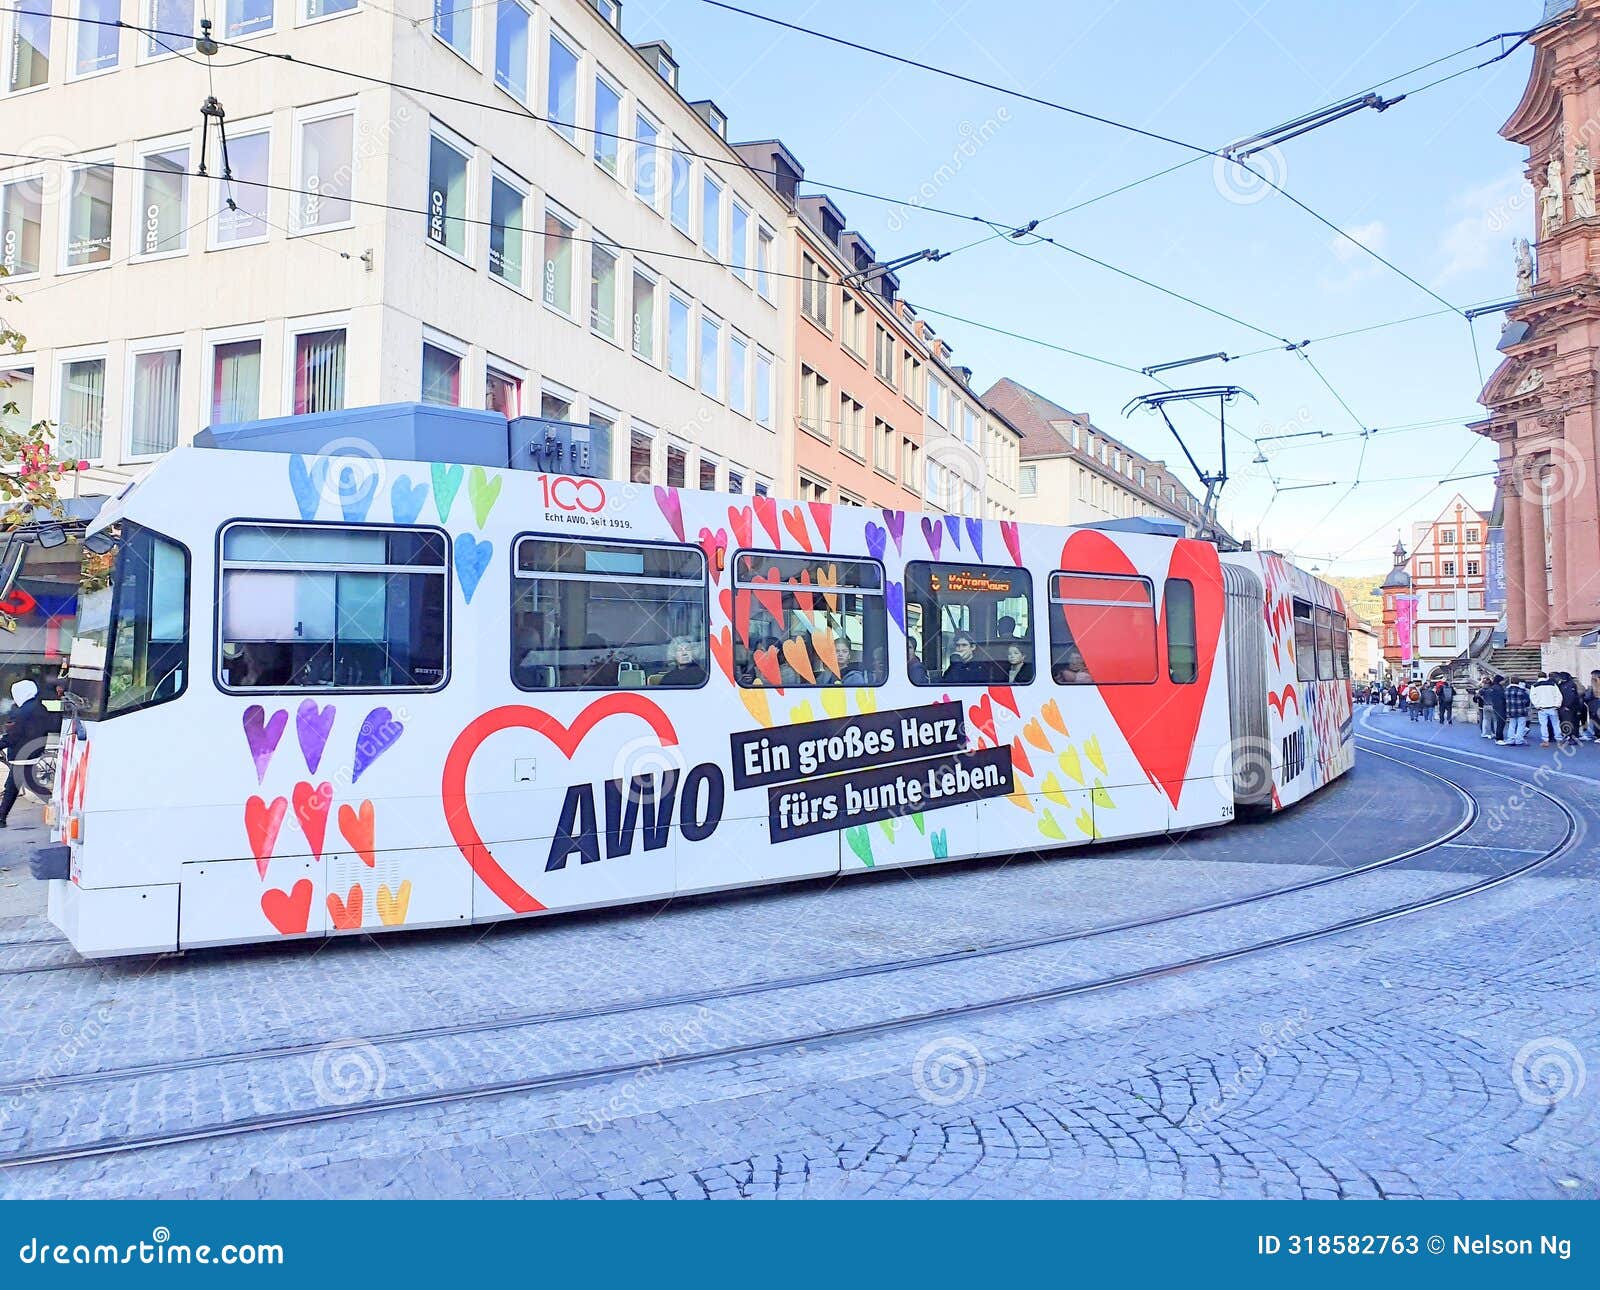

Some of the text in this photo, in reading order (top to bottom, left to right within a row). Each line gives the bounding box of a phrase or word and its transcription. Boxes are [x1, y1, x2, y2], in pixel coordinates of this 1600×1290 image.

[146, 204, 159, 252] ERGO
[431, 190, 443, 242] ERGO
[4, 230, 16, 274] ERGO
[537, 474, 606, 513] 100
[545, 512, 633, 529] Echt AWO. Seit 1919.
[743, 716, 958, 776] Ein großes Herz
[1281, 724, 1305, 787] AWO
[545, 762, 725, 873] AWO
[779, 762, 1007, 830] fürs bunte Leben.
[1222, 806, 1233, 817] 214
